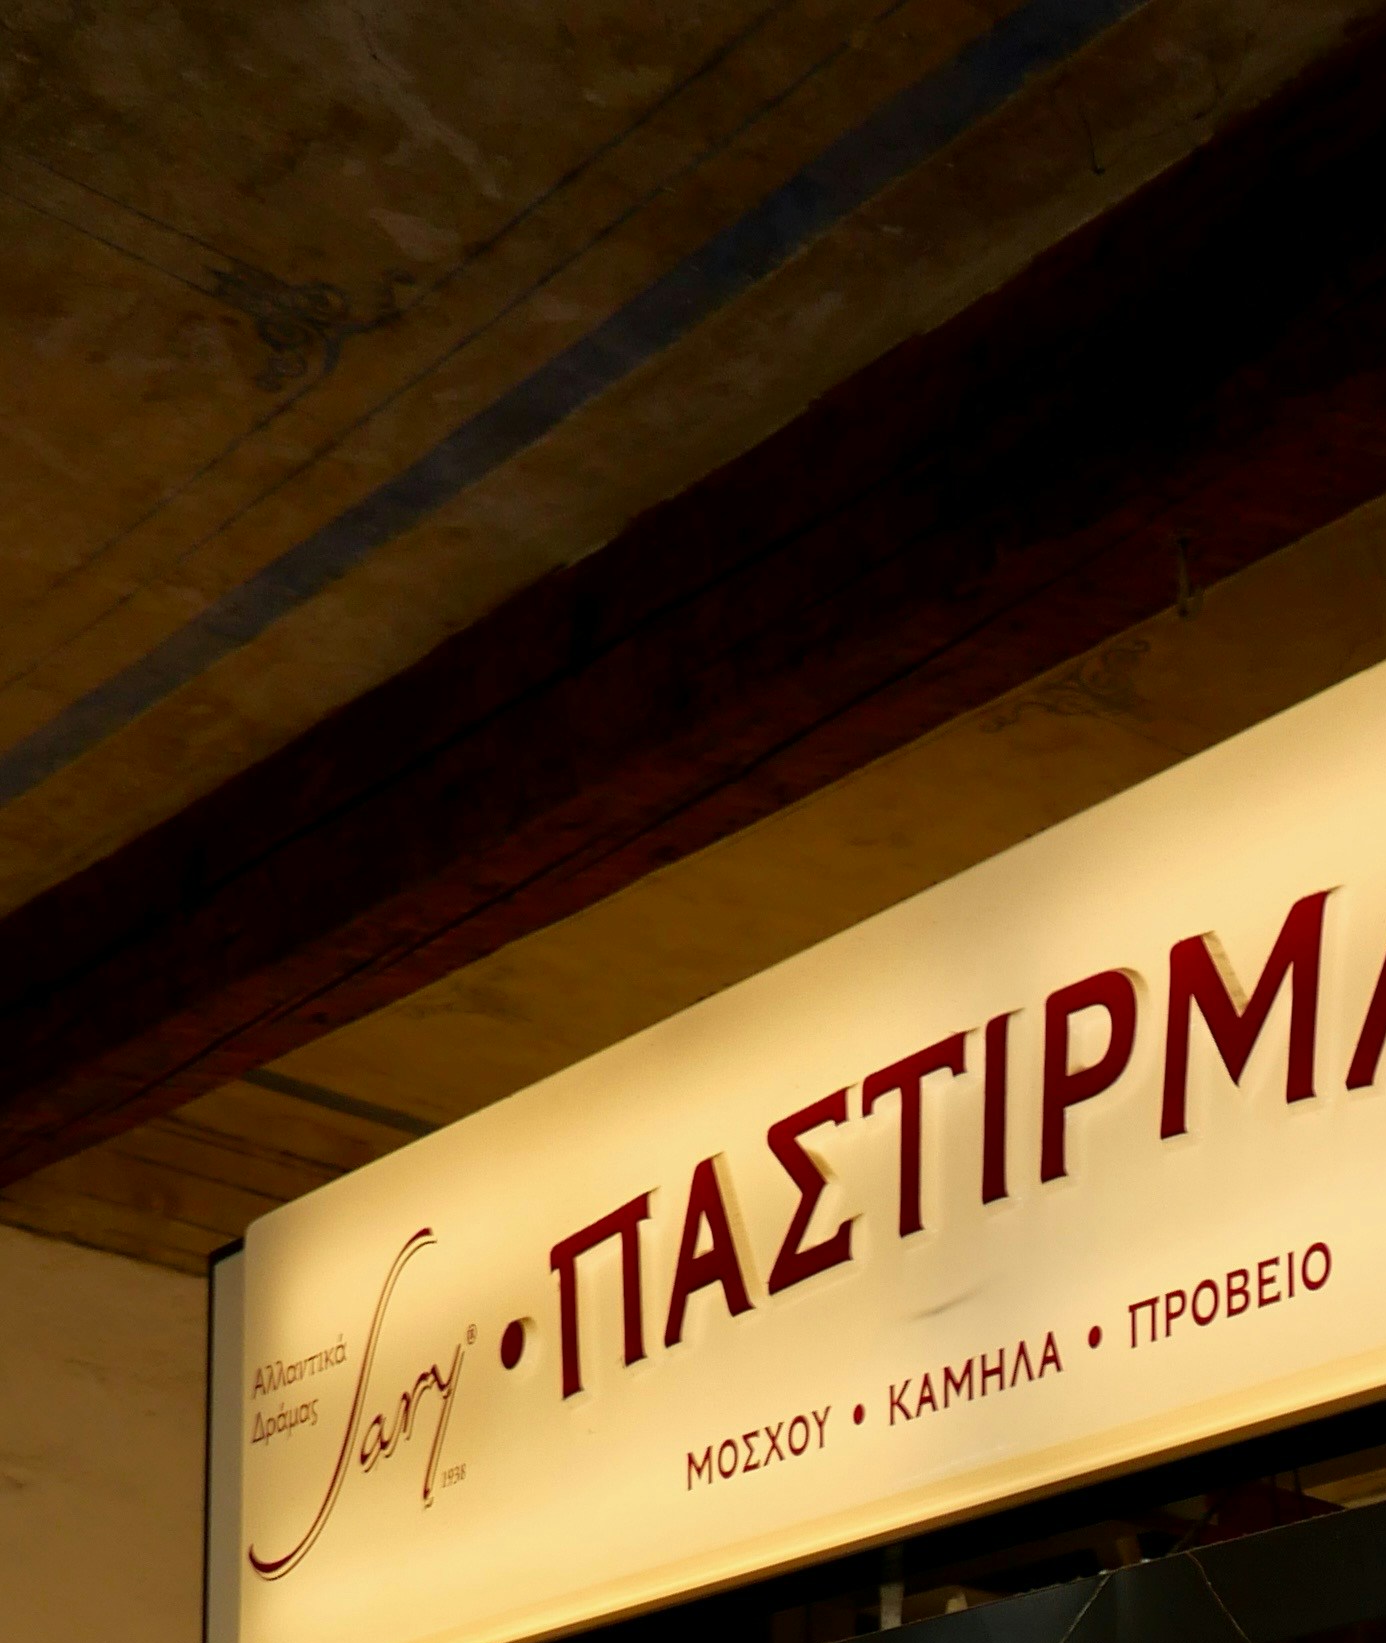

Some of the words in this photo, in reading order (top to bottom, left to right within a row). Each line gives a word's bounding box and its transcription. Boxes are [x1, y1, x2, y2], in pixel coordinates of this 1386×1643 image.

[252, 1333, 349, 1400] Αλλαντικά
[687, 1405, 831, 1491] ΜΟΣΧΟΥ
[889, 1331, 1063, 1426] ΚΑΜΗΛΑ
[1127, 1241, 1332, 1349] ΠΡΟΒΕΙΟ
[251, 1398, 320, 1446] Δράμας
[441, 1462, 468, 1489] 1938
